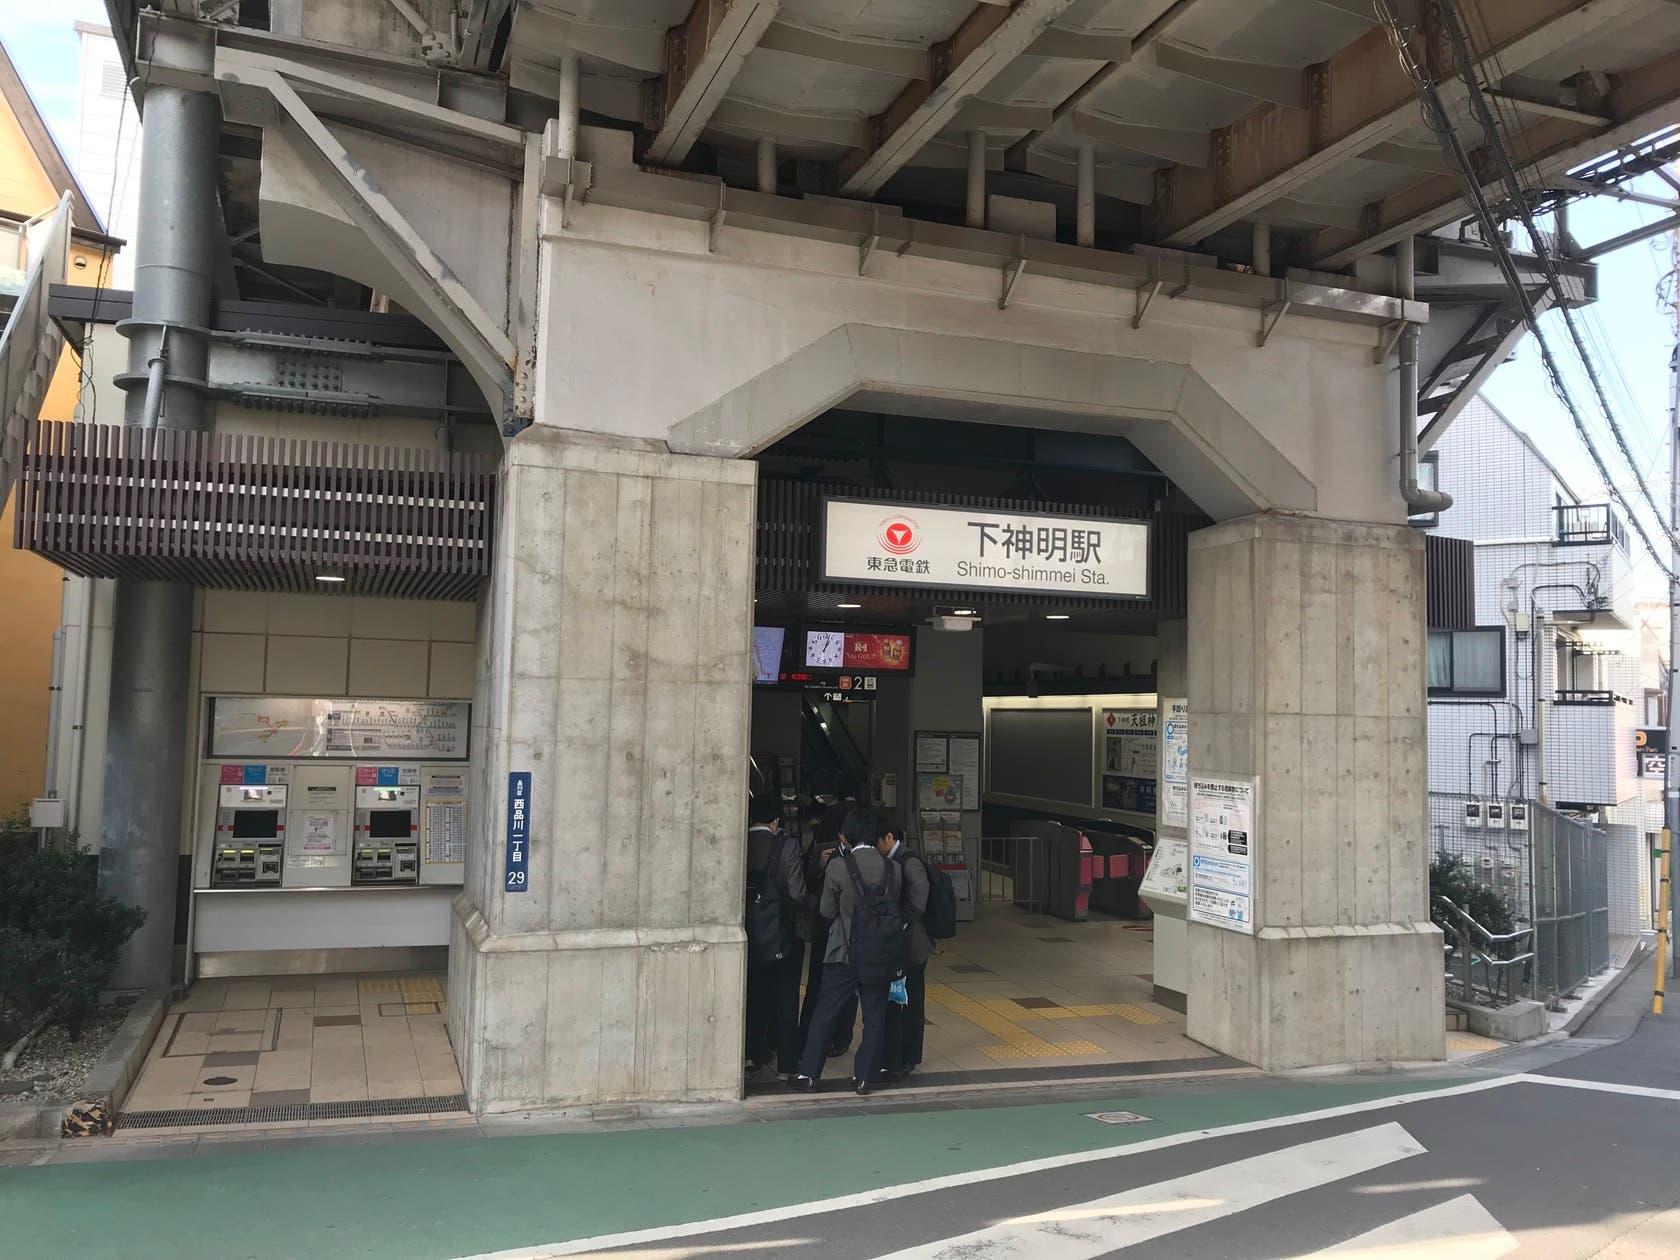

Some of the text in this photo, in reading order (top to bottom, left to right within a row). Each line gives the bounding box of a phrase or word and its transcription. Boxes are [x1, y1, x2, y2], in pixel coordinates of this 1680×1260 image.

[967, 521, 1102, 564] 下神明駅
[866, 556, 931, 574] 東急電鉄
[957, 560, 1110, 585] Shimo-shimmei Sta.
[854, 676, 863, 690] 2
[512, 798, 525, 862] 西品川一丁目
[507, 871, 525, 884] 29
